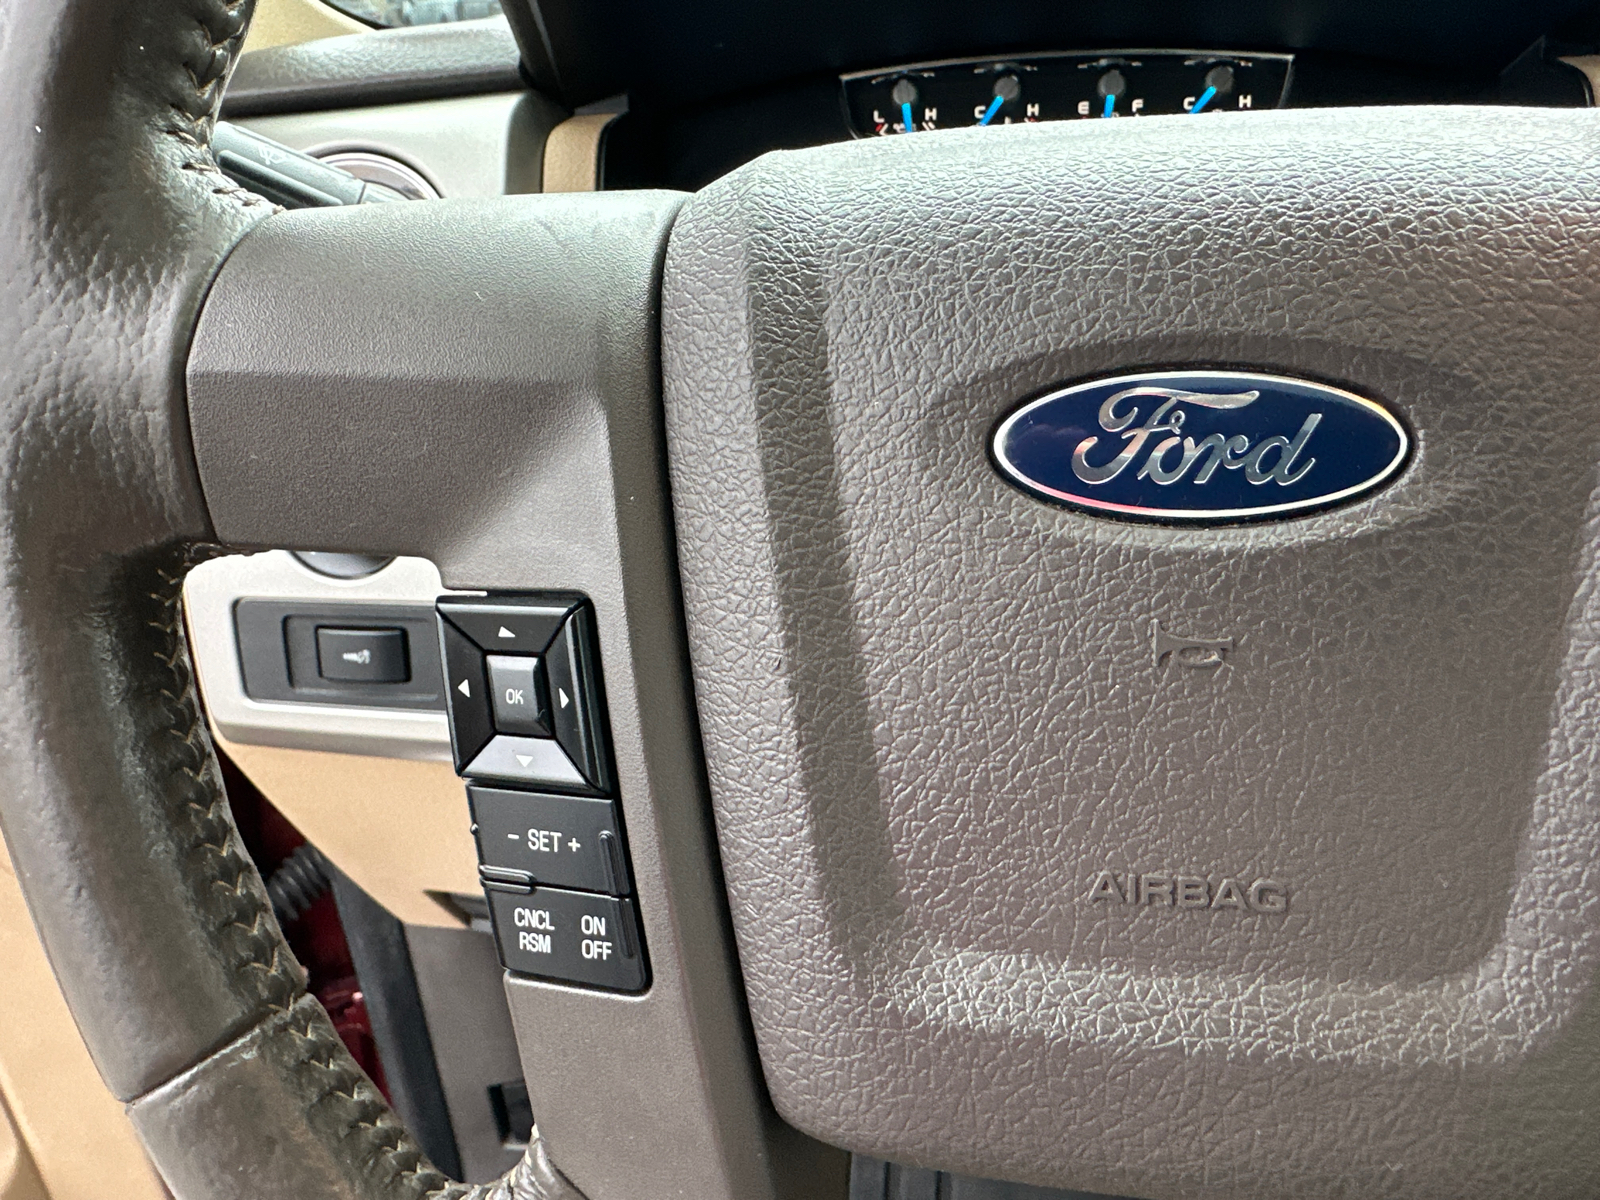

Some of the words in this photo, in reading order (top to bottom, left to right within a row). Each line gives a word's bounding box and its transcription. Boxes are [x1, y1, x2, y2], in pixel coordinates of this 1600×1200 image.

[974, 105, 986, 119] C
[1026, 103, 1040, 117] H
[1077, 100, 1090, 115] E
[1131, 98, 1144, 113] F
[1183, 96, 1195, 110] C
[1238, 94, 1252, 109] H
[873, 110, 885, 123] L
[924, 107, 937, 121] H
[1071, 386, 1322, 486] Ford
[505, 688, 524, 705] OK
[527, 830, 562, 853] SET
[1087, 869, 1287, 913] AIRBAG
[513, 907, 556, 932] CNCL
[580, 914, 606, 937] ON
[518, 930, 552, 954] RSM
[581, 938, 613, 961] OFF
